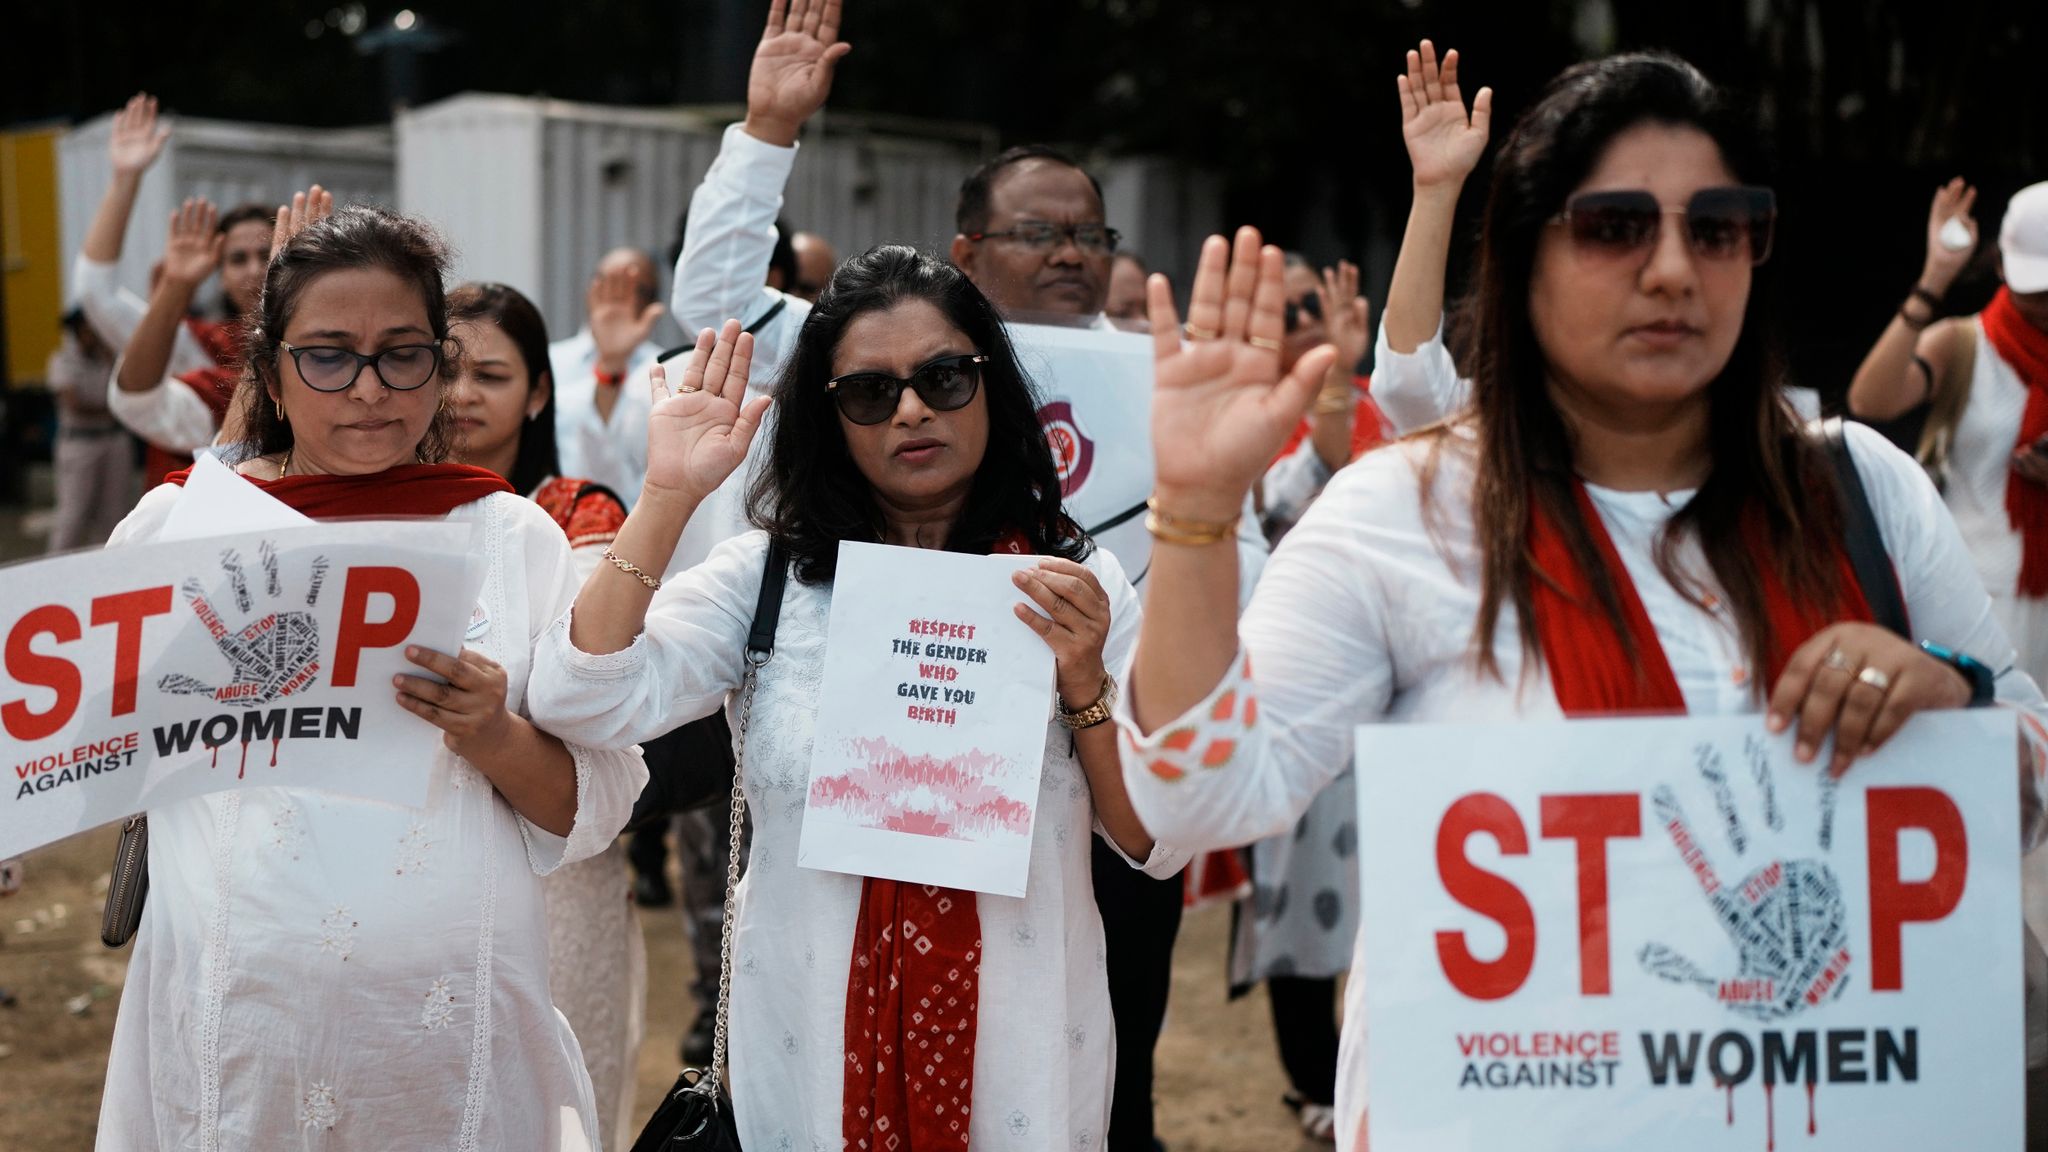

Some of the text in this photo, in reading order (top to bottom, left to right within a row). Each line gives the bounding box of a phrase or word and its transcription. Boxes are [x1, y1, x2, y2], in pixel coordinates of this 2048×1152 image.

[190, 595, 229, 640] VIOLENCE
[244, 613, 277, 640] STOP
[289, 617, 318, 641] INSULT
[908, 618, 976, 641] RESPECT
[275, 612, 288, 671] INDIFFERENCE
[892, 638, 988, 664] THE GENDER
[217, 637, 273, 679] HUMILIATION
[263, 641, 319, 701] MISTREATMENT
[919, 662, 959, 682] WHO
[214, 683, 259, 701] ABUSE
[279, 661, 320, 697] WOMEN
[897, 682, 976, 705] GAVE YOU
[907, 705, 957, 726] BIRTH
[153, 706, 362, 759] WOMEN
[15, 732, 140, 780] VIOLENCE
[16, 748, 139, 801] AGAINST
[1668, 816, 1722, 895] VIOLENCE
[1743, 861, 1783, 903] STOP
[1718, 979, 1774, 1003] ABUSE
[1456, 1031, 1619, 1058] VIOLENCE
[1641, 1027, 1919, 1087] WOMEN
[1460, 1060, 1621, 1088] AGAINST
